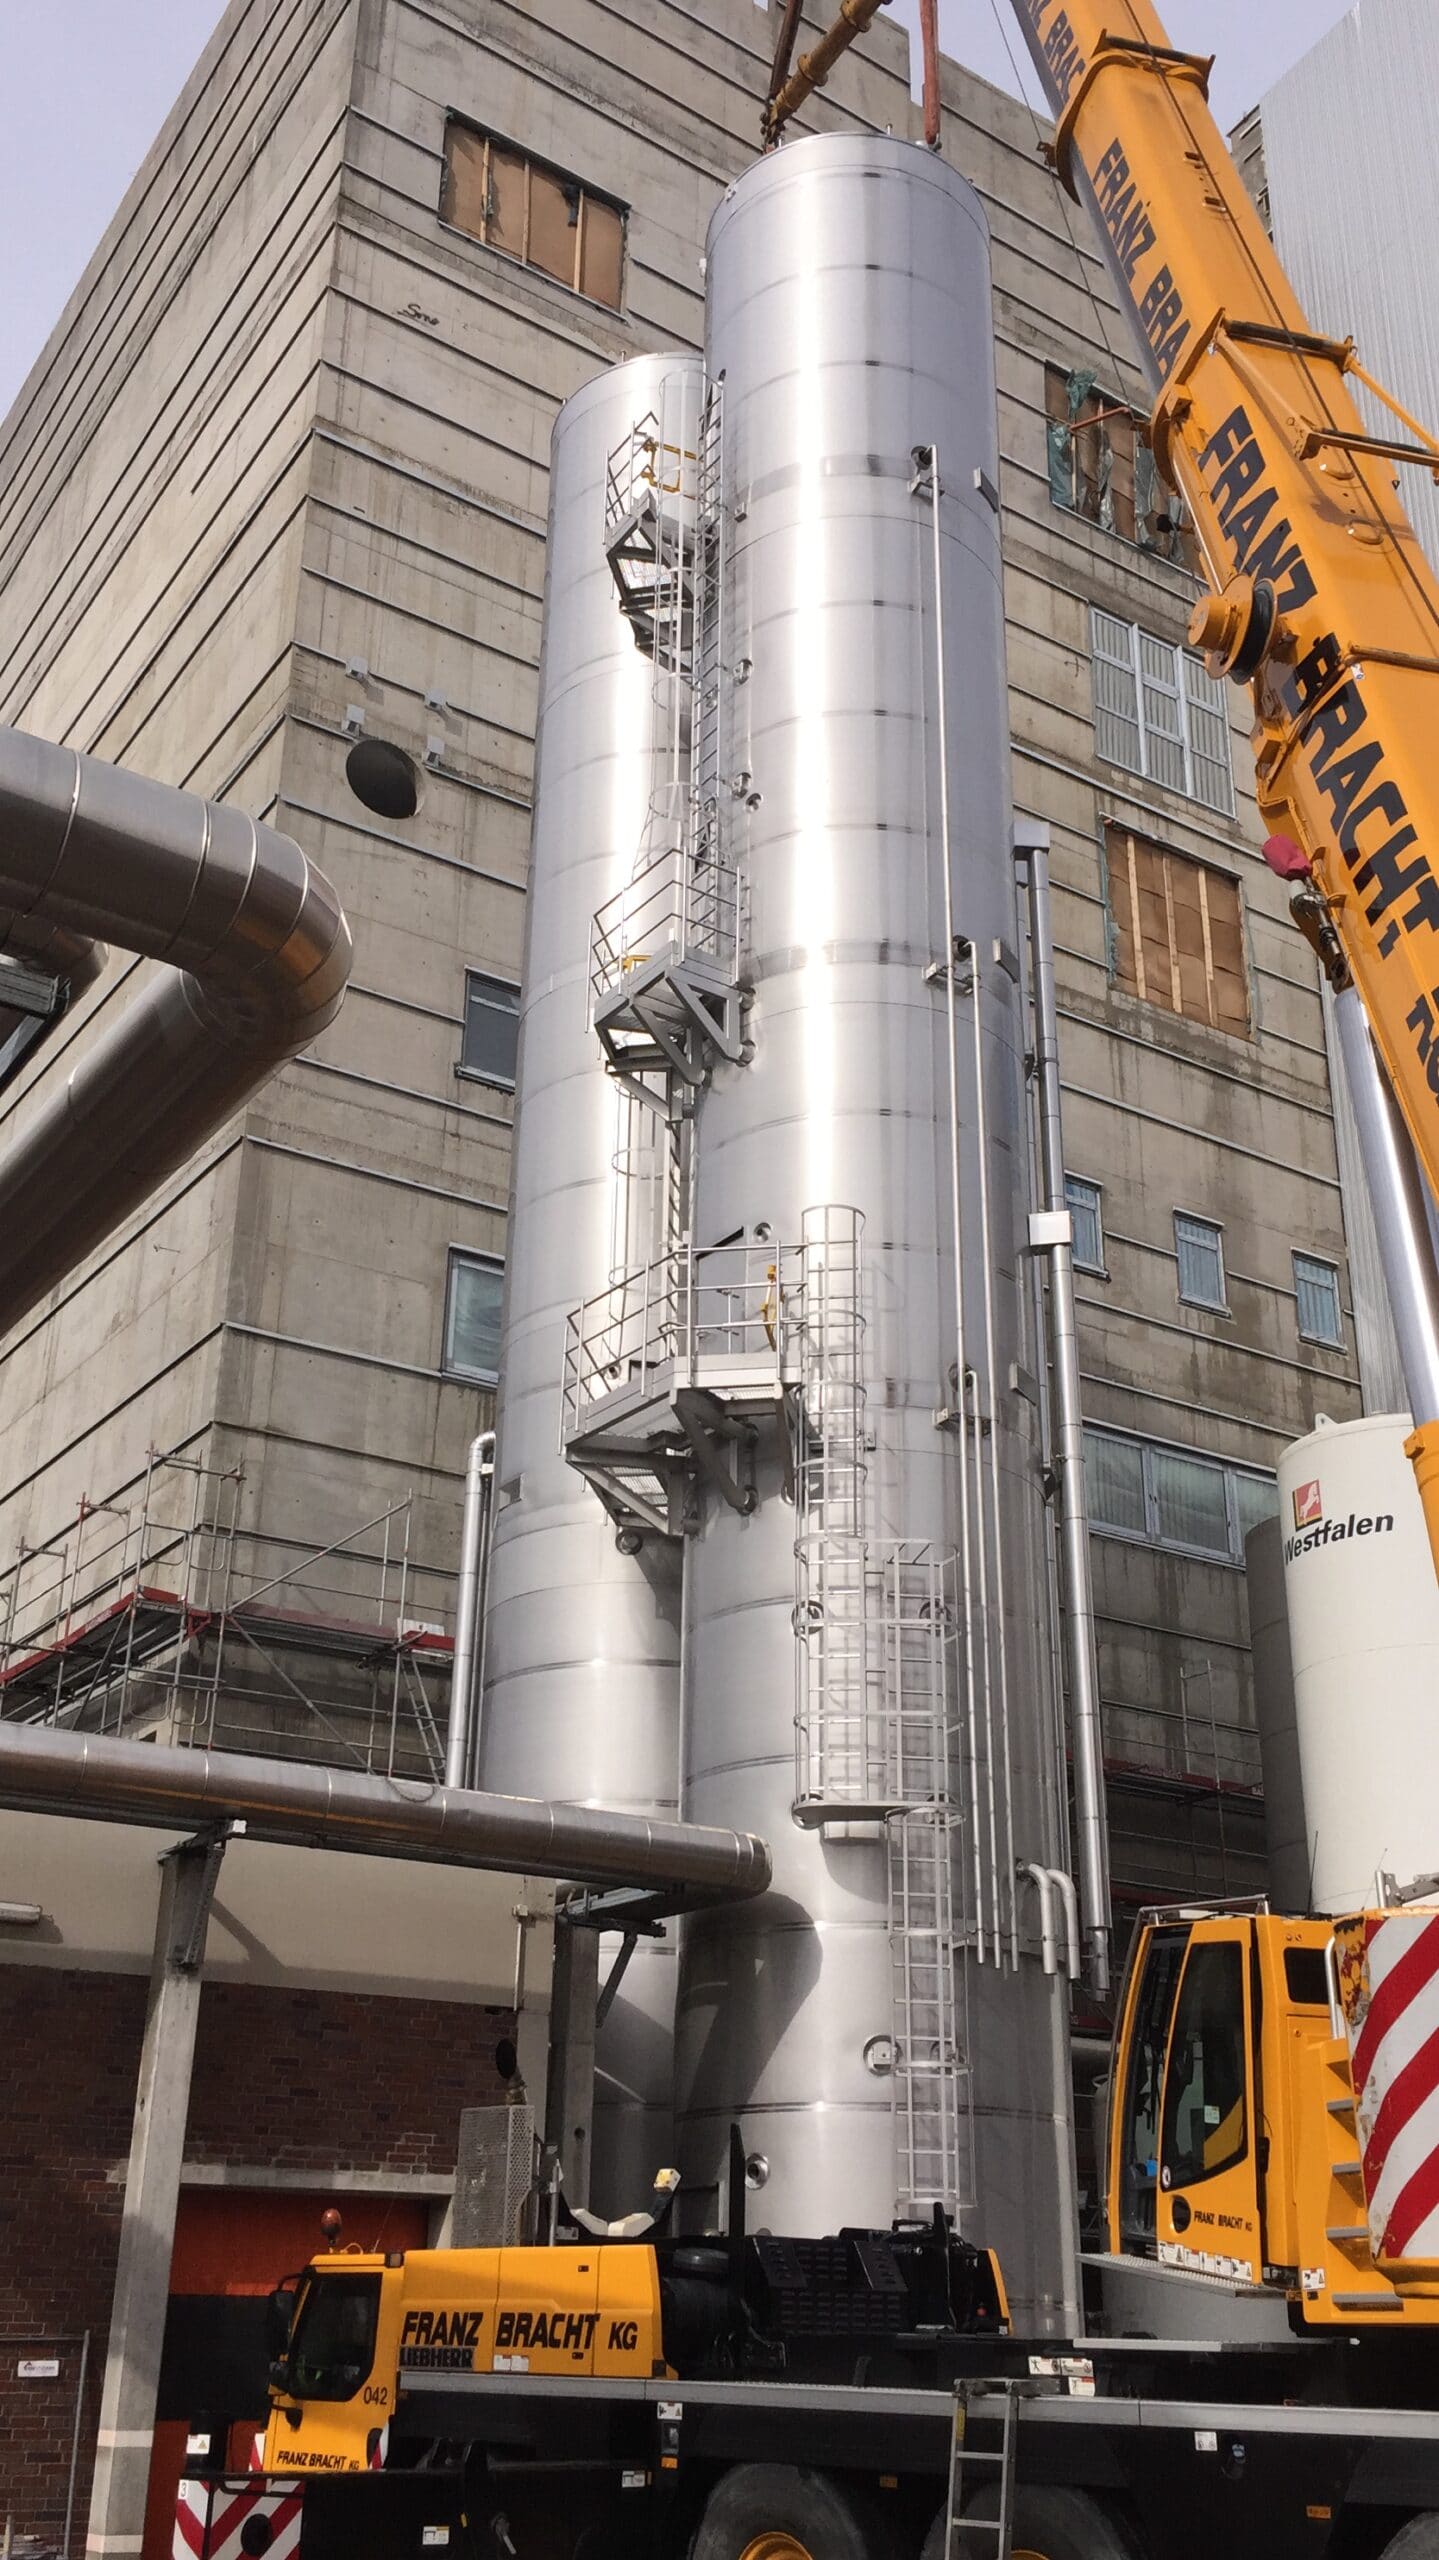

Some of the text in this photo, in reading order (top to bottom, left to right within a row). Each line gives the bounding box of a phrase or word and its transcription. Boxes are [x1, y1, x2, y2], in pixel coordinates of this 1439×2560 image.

[1093, 137, 1157, 285] FRANZ
[1197, 404, 1318, 615] FRANZ
[1285, 1513, 1394, 1566] Westfalen
[1193, 2210, 1215, 2225] FRANZ
[1218, 2213, 1243, 2230] BRACHT
[400, 2311, 639, 2350] FRANZ BRACHT KG
[399, 2347, 474, 2369] LIEBHERR
[363, 2385, 388, 2405] 042
[277, 2450, 308, 2466] FRANZ
[309, 2453, 347, 2470] BRACHT
